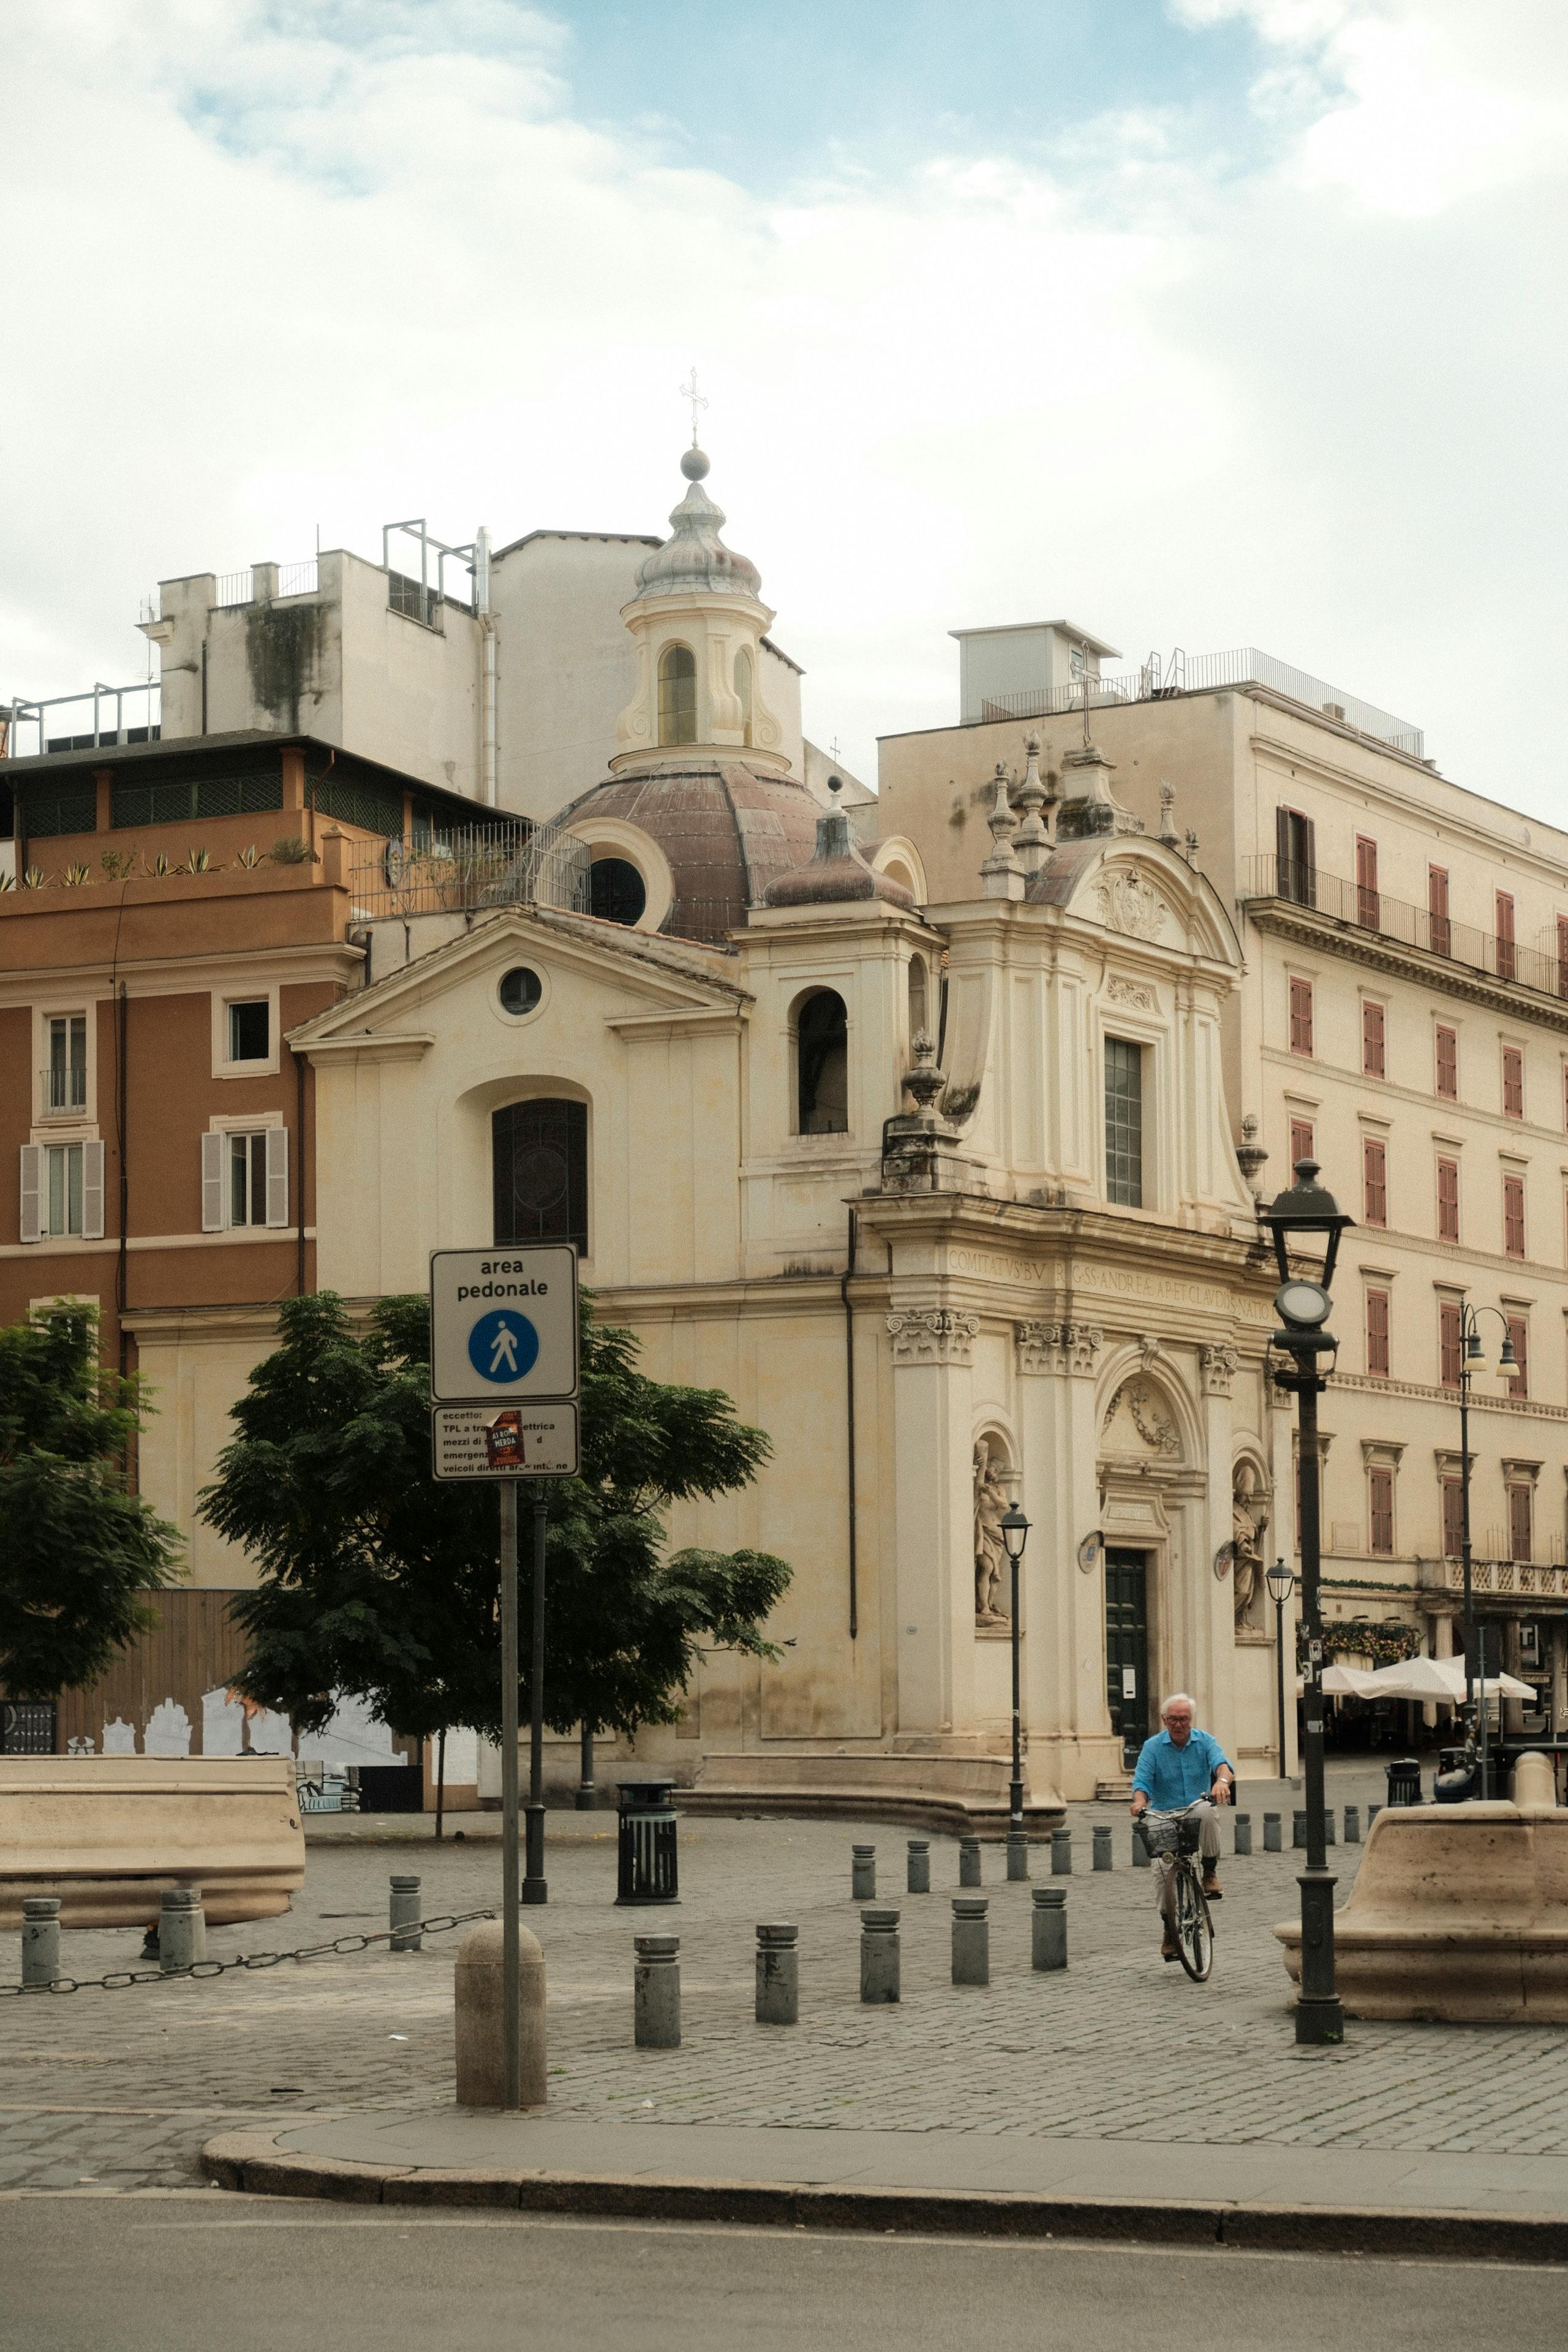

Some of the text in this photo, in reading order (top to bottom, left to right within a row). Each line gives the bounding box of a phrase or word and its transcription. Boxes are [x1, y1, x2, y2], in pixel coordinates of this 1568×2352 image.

[481, 1260, 524, 1275] area
[458, 1279, 548, 1302] pedonale
[523, 1422, 555, 1431] ettrica
[443, 1438, 470, 1446] mezzi
[495, 1437, 516, 1447] MERDA
[443, 1452, 489, 1460] emergenz
[443, 1464, 474, 1472] veicoli
